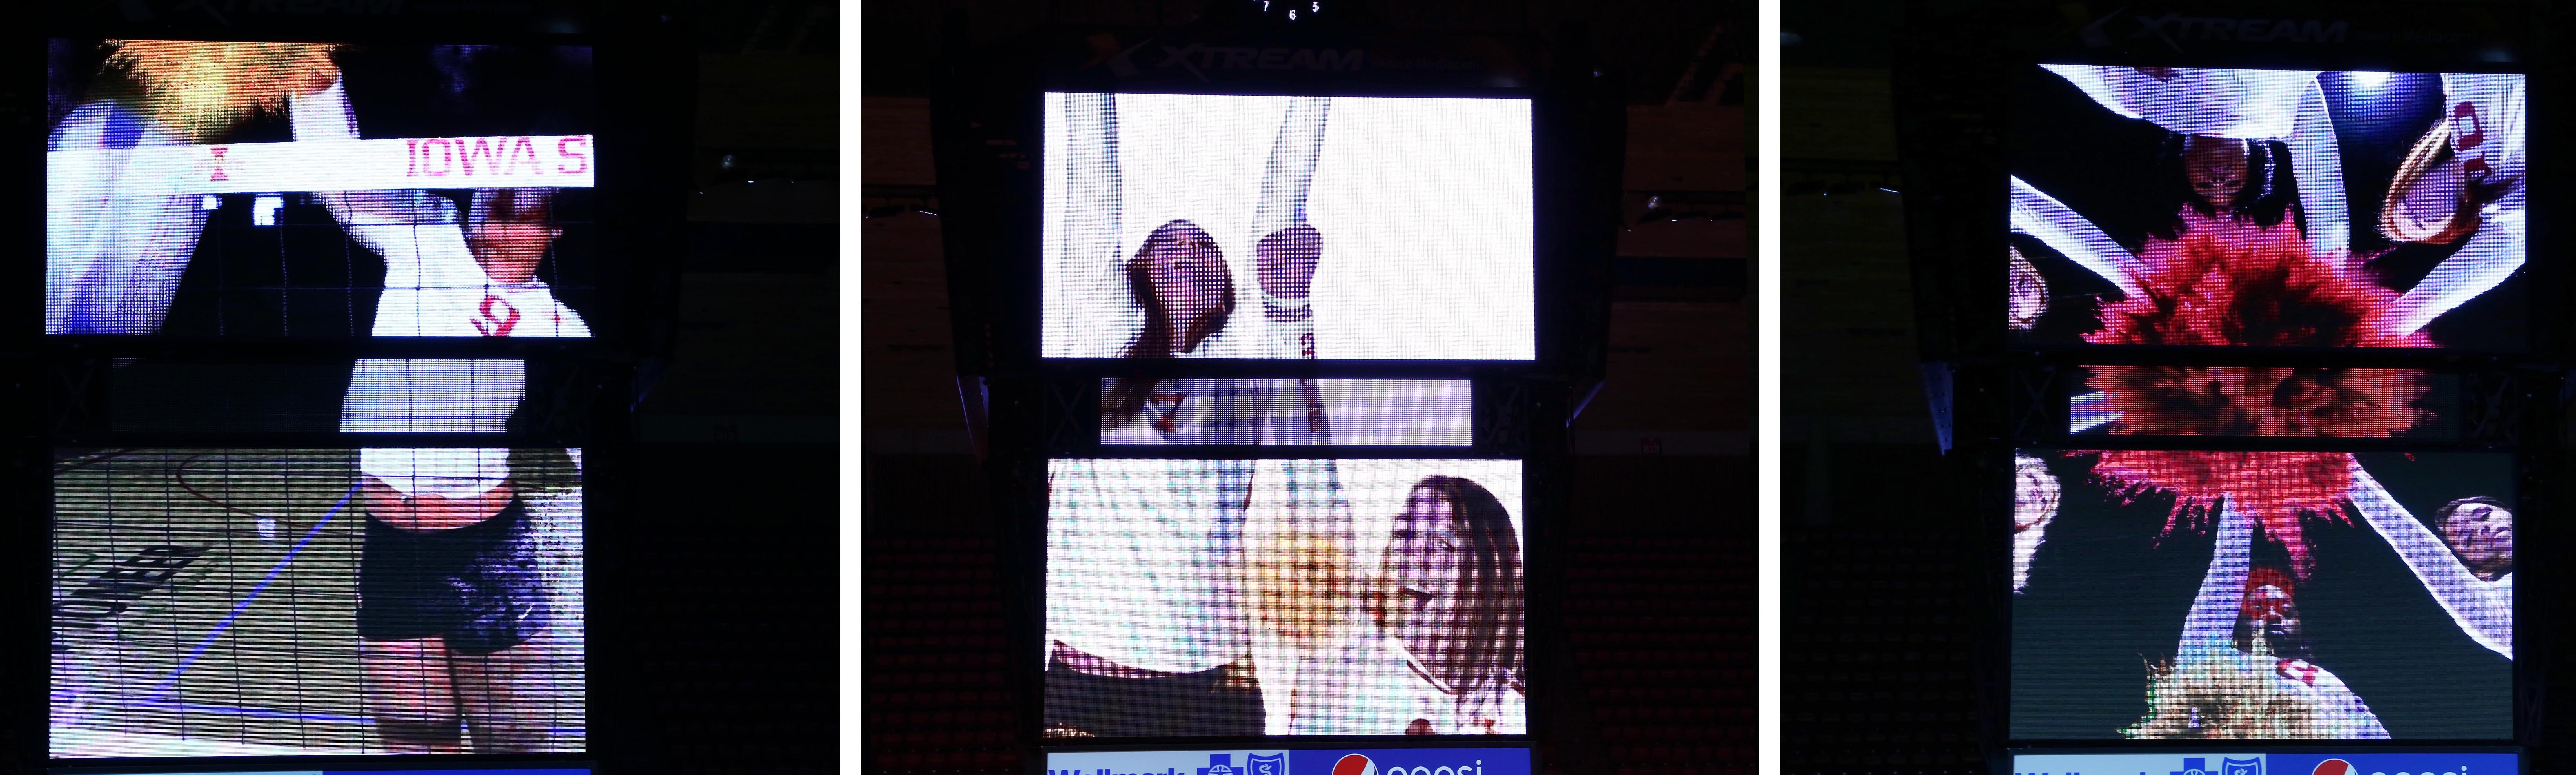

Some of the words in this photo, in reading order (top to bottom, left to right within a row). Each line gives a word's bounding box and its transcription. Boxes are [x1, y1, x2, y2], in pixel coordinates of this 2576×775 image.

[1263, 1, 1270, 11] 7
[1312, 2, 1319, 12] 5
[1289, 9, 1297, 20] 6
[2127, 12, 2349, 54] XTREAM
[1154, 42, 1364, 82] XTREAM
[406, 138, 545, 177] IOWA
[557, 135, 588, 175] S
[1643, 445, 1660, 453] 213
